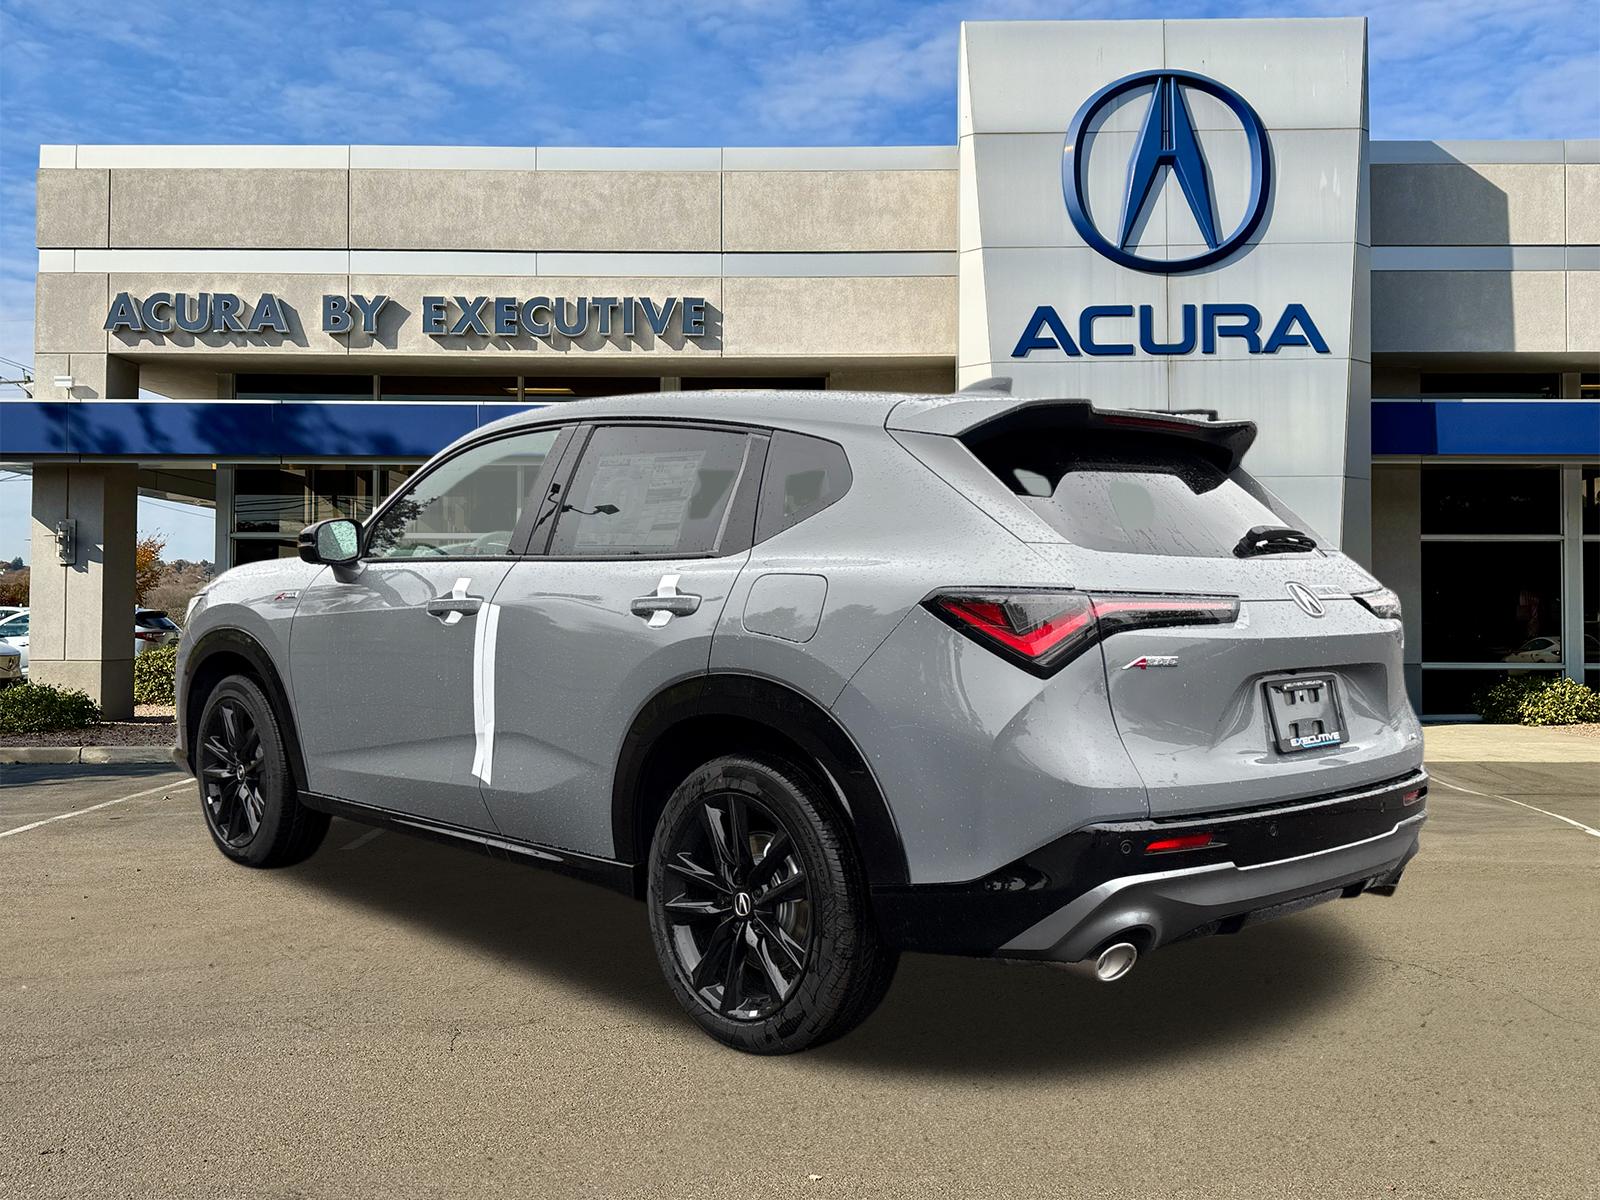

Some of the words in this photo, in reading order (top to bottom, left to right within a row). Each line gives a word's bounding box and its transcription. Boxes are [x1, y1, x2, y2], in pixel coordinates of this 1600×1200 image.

[104, 292, 288, 333] ACURA
[322, 294, 390, 334] BY
[421, 296, 706, 336] EXECUTIVE
[1011, 303, 1331, 356] ACURA
[1290, 732, 1340, 747] EXECUTIVE
